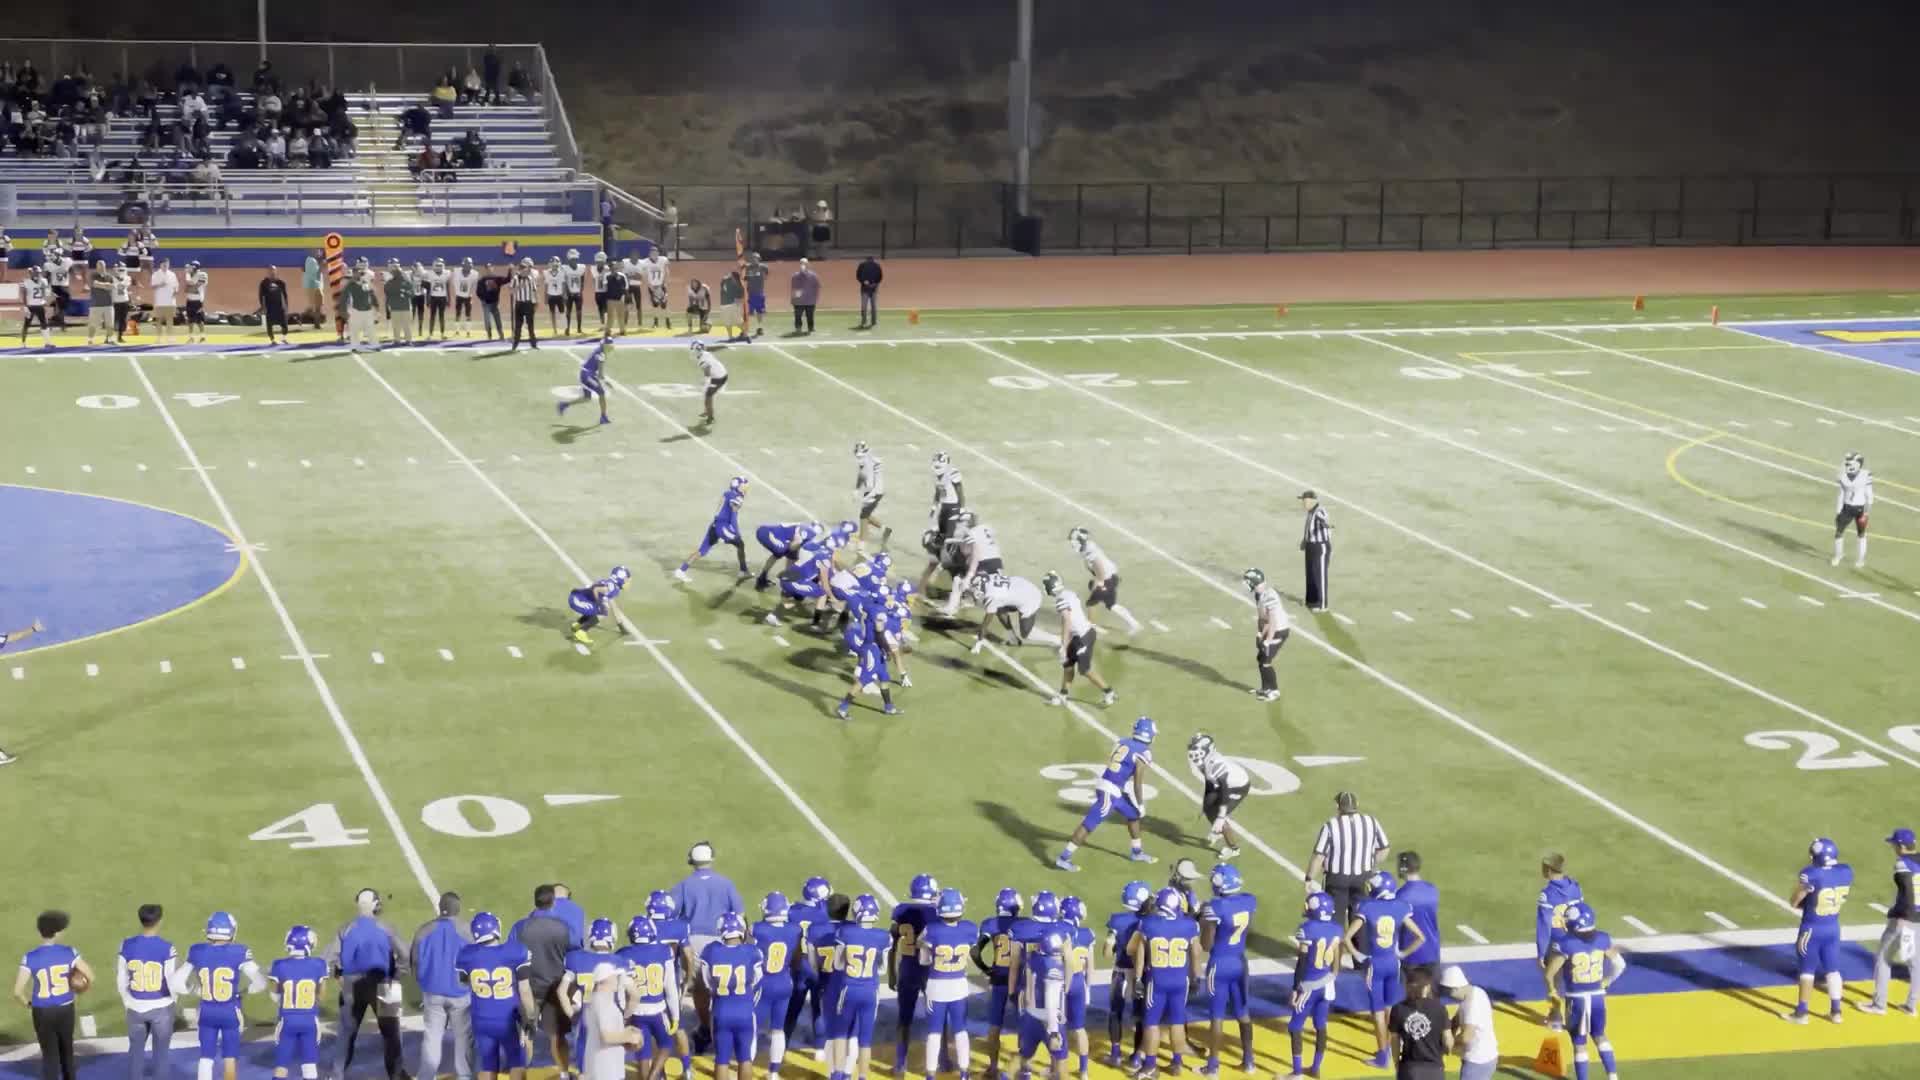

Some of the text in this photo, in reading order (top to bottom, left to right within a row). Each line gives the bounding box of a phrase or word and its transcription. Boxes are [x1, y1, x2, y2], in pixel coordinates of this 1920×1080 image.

[1230, 911, 1249, 945] 7
[1376, 915, 1395, 948] 9
[766, 941, 788, 974] 8
[845, 944, 877, 978] 51
[1149, 936, 1189, 968] 66
[36, 963, 71, 999] 15
[127, 959, 163, 993] 30
[198, 966, 235, 1002] 16
[469, 966, 514, 1000] 62
[712, 964, 746, 996] 71
[281, 979, 317, 1009] 18
